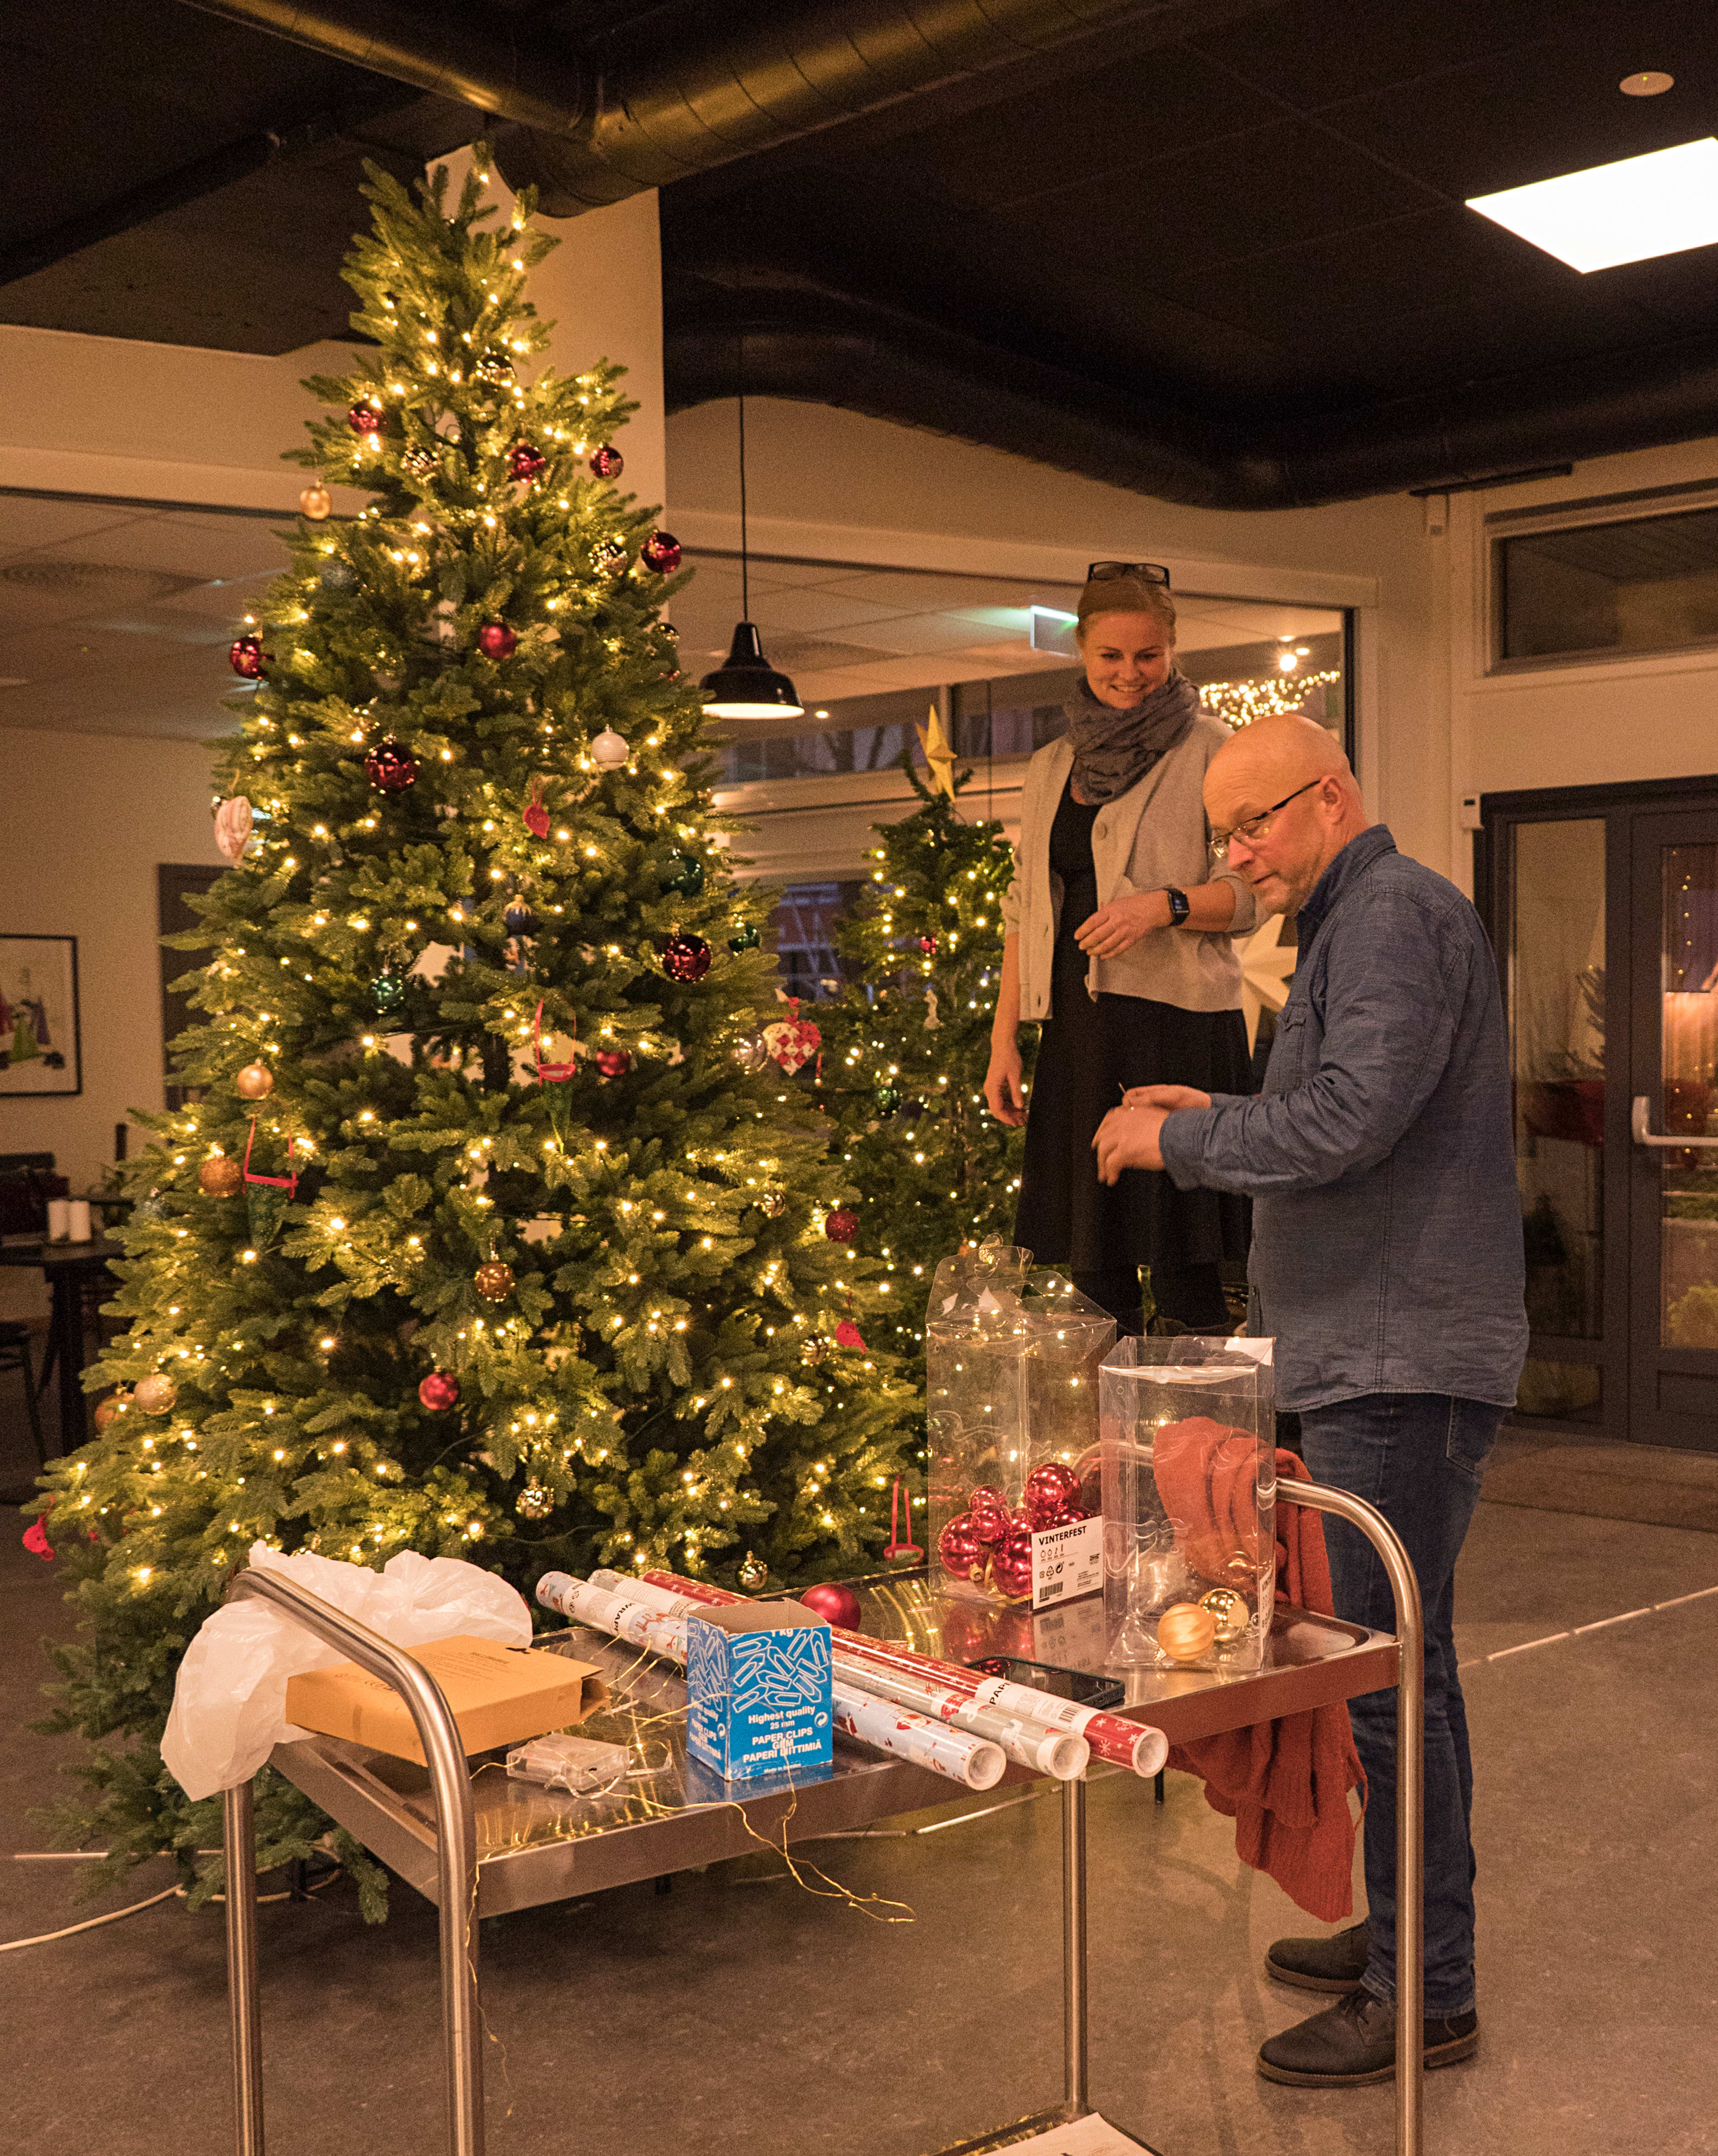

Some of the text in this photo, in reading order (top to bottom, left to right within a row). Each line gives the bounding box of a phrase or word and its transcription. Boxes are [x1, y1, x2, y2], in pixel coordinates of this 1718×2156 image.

[1039, 1526, 1086, 1545] VINTERFEST
[748, 1705, 816, 1724] Highest quality
[770, 1721, 780, 1730] 25
[752, 1727, 813, 1745] PAPER CLIPS
[772, 1739, 794, 1749] GEM
[743, 1749, 777, 1763] PAPERI
